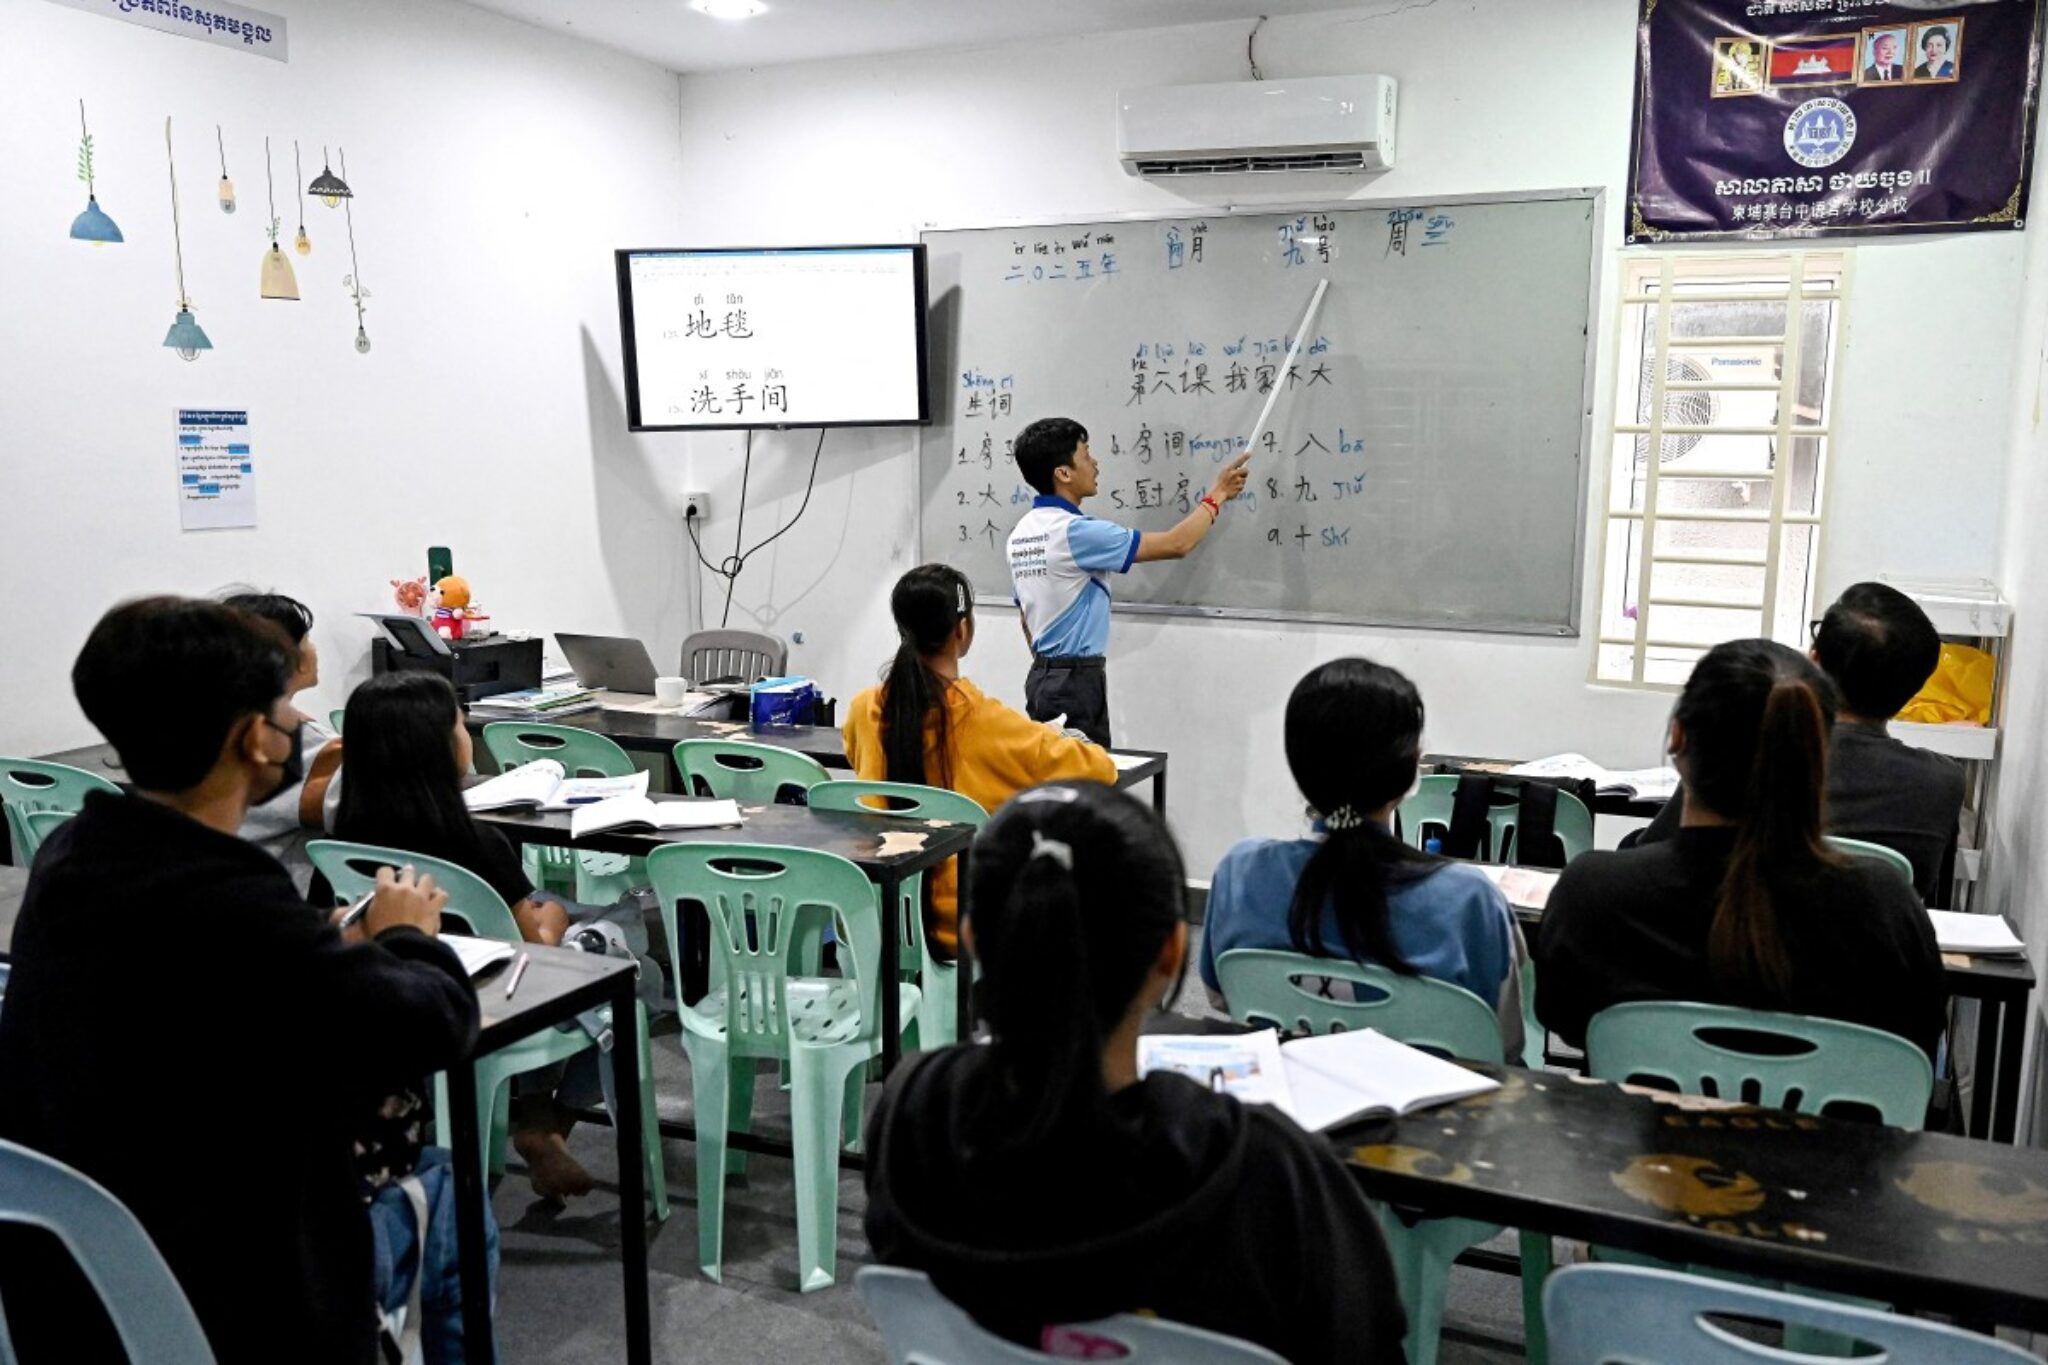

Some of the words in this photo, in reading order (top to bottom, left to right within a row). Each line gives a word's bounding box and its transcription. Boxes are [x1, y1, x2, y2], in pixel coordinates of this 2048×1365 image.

[685, 308, 753, 339] 地毯
[1711, 356, 1762, 367] Panasonic
[691, 382, 787, 415] 洗手间
